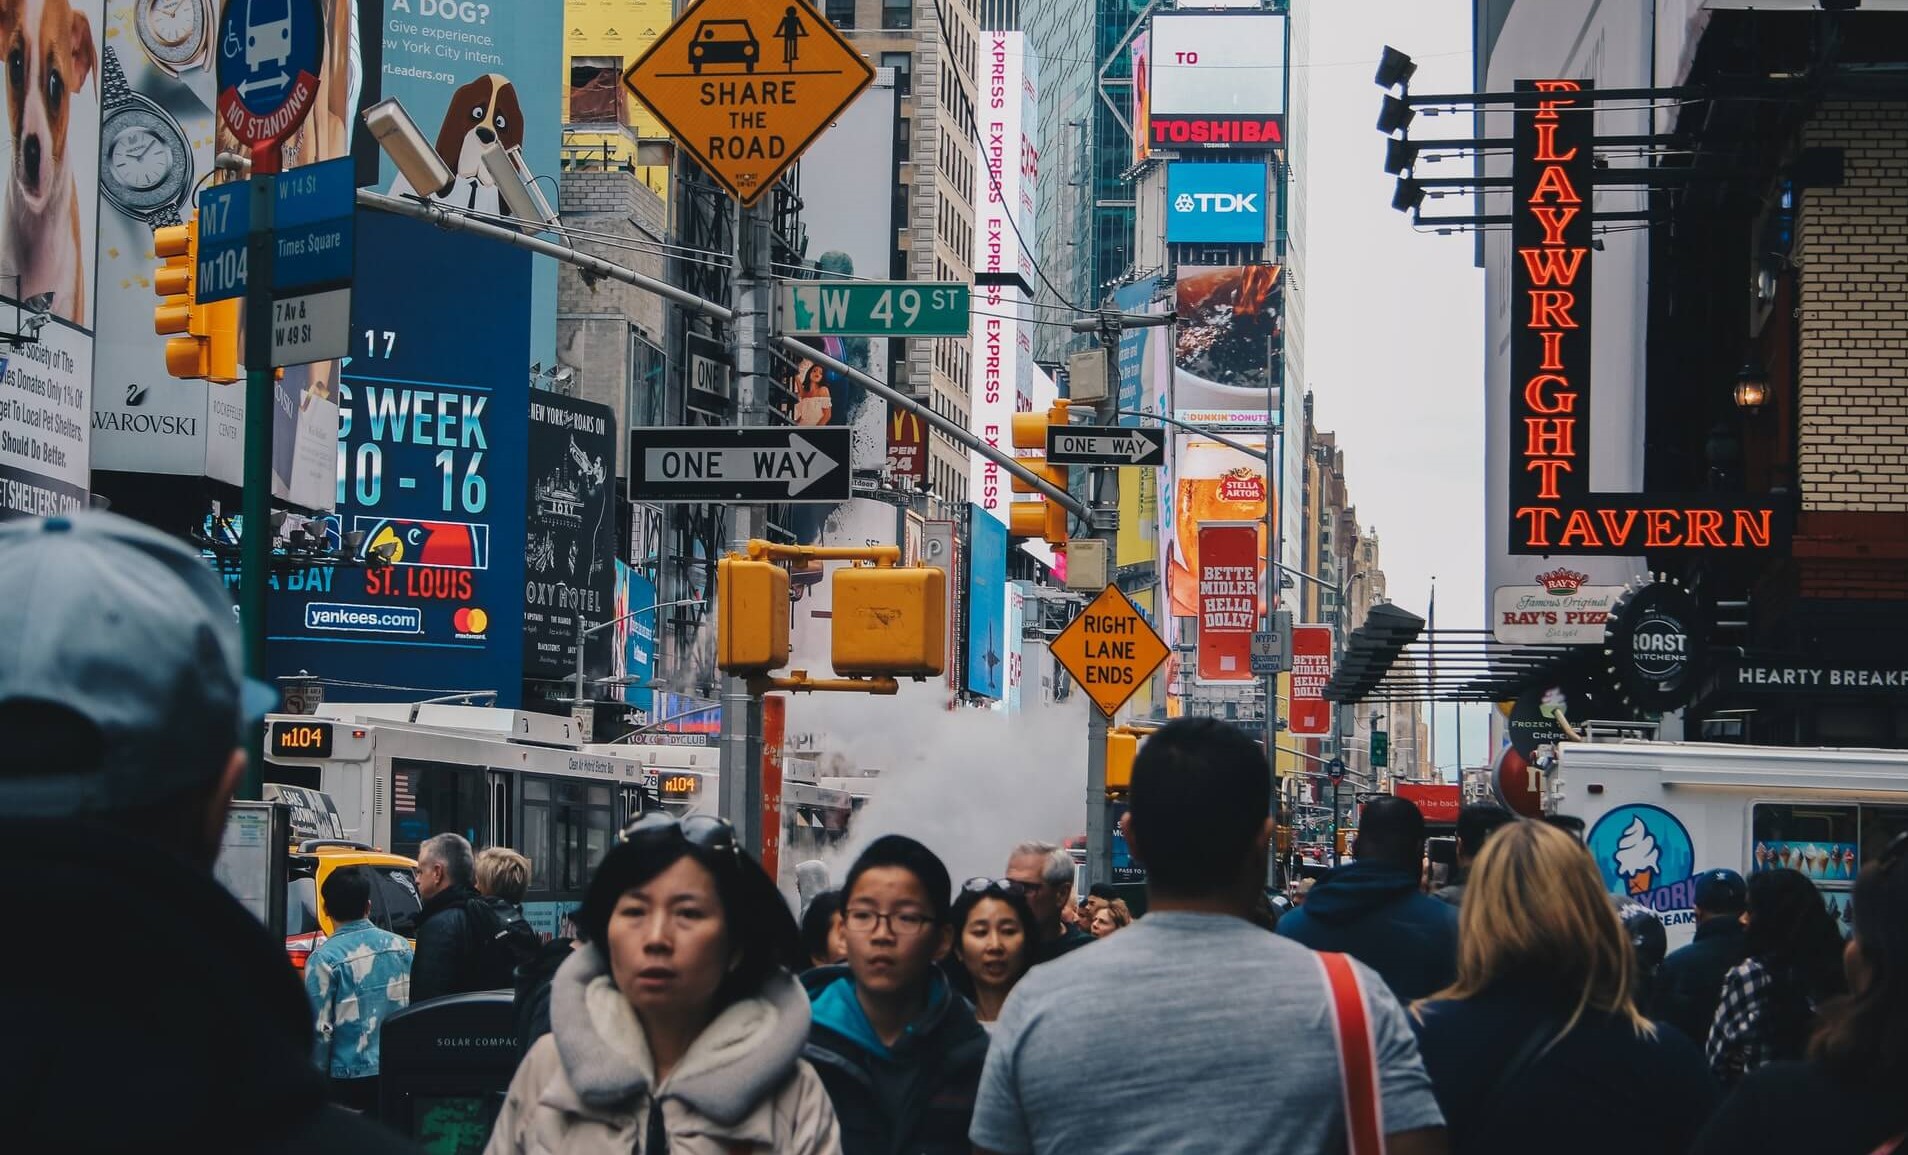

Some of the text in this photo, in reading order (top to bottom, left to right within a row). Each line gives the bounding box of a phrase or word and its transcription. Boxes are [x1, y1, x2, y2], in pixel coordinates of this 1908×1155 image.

[392, 0, 490, 25] A DOG?
[389, 19, 494, 46] Give experience.
[382, 38, 504, 66] ew York City intern.
[1175, 52, 1198, 65] TO
[383, 63, 455, 85] rLeaders.org
[990, 30, 1006, 109] EXPRESS
[700, 81, 796, 106] SHARE
[227, 83, 311, 140] NO STANDING
[729, 112, 767, 129] THE
[1151, 120, 1281, 143] TOSHIBA
[709, 136, 785, 161] ROAD
[988, 121, 1003, 204] EXPRESS
[279, 174, 317, 200] W 14 St
[1193, 193, 1258, 213] TDK
[278, 231, 341, 257] Times Square
[200, 247, 248, 294] M104
[1518, 81, 1588, 498] PLAYWRIGHT
[276, 300, 306, 322] 7 Av &
[821, 289, 959, 329] W 49 ST
[275, 324, 311, 347] W 49 St
[26, 342, 52, 370] Society
[53, 349, 61, 369] of
[61, 350, 74, 374] The
[985, 318, 1000, 404] EXPRESS
[17, 367, 46, 397] Donates
[47, 378, 62, 406] Only
[698, 360, 720, 393] ONE
[0, 398, 11, 421] get
[13, 399, 21, 422] To
[22, 402, 42, 428] Local
[43, 409, 54, 432] Pet
[91, 411, 197, 437] WAROVSKI
[365, 386, 488, 450] WEEK
[530, 402, 546, 422] NEW
[546, 406, 564, 427] YORK
[573, 412, 594, 433] ROARS
[595, 418, 606, 436] ON
[218, 423, 238, 440] CENTER
[2, 429, 67, 468] Should Do Better.
[888, 446, 917, 455] PEN
[1063, 437, 1147, 454] ONE WAY
[661, 451, 817, 479] ONE WAY
[885, 456, 913, 471] 24
[983, 425, 999, 510] EXRESS
[435, 450, 488, 514] 16
[1226, 481, 1259, 490] STELLA
[1226, 489, 1260, 497] ARTOIS
[1515, 506, 1773, 547] TAVERN
[366, 566, 400, 596] ST.
[407, 568, 473, 600] LOUIS
[1203, 566, 1254, 581] BETTE
[1547, 580, 1578, 589] RAY'S
[525, 580, 558, 607] OXY
[1200, 581, 1257, 595] MIDLER
[1516, 595, 1609, 611] Famous Original
[311, 608, 416, 628] yankees.com
[1084, 615, 1137, 635] RIGHT
[1204, 612, 1254, 628] DOLLY!
[1502, 611, 1609, 625] RAY'S PIZZ
[1084, 640, 1136, 660] LANE
[1255, 634, 1278, 644] NYPD
[1291, 665, 1330, 675] MIDLER
[1293, 654, 1328, 665] BETTE
[1085, 665, 1134, 685] ENDS
[1293, 676, 1327, 687] HELLO
[1738, 668, 1823, 685] HEARTY
[1293, 687, 1323, 698] DOLLY
[1511, 720, 1552, 728] FROZEN
[568, 757, 579, 771] Clean
[1463, 780, 1495, 796] REN
[437, 1037, 519, 1047] SOLAR COMPAC
